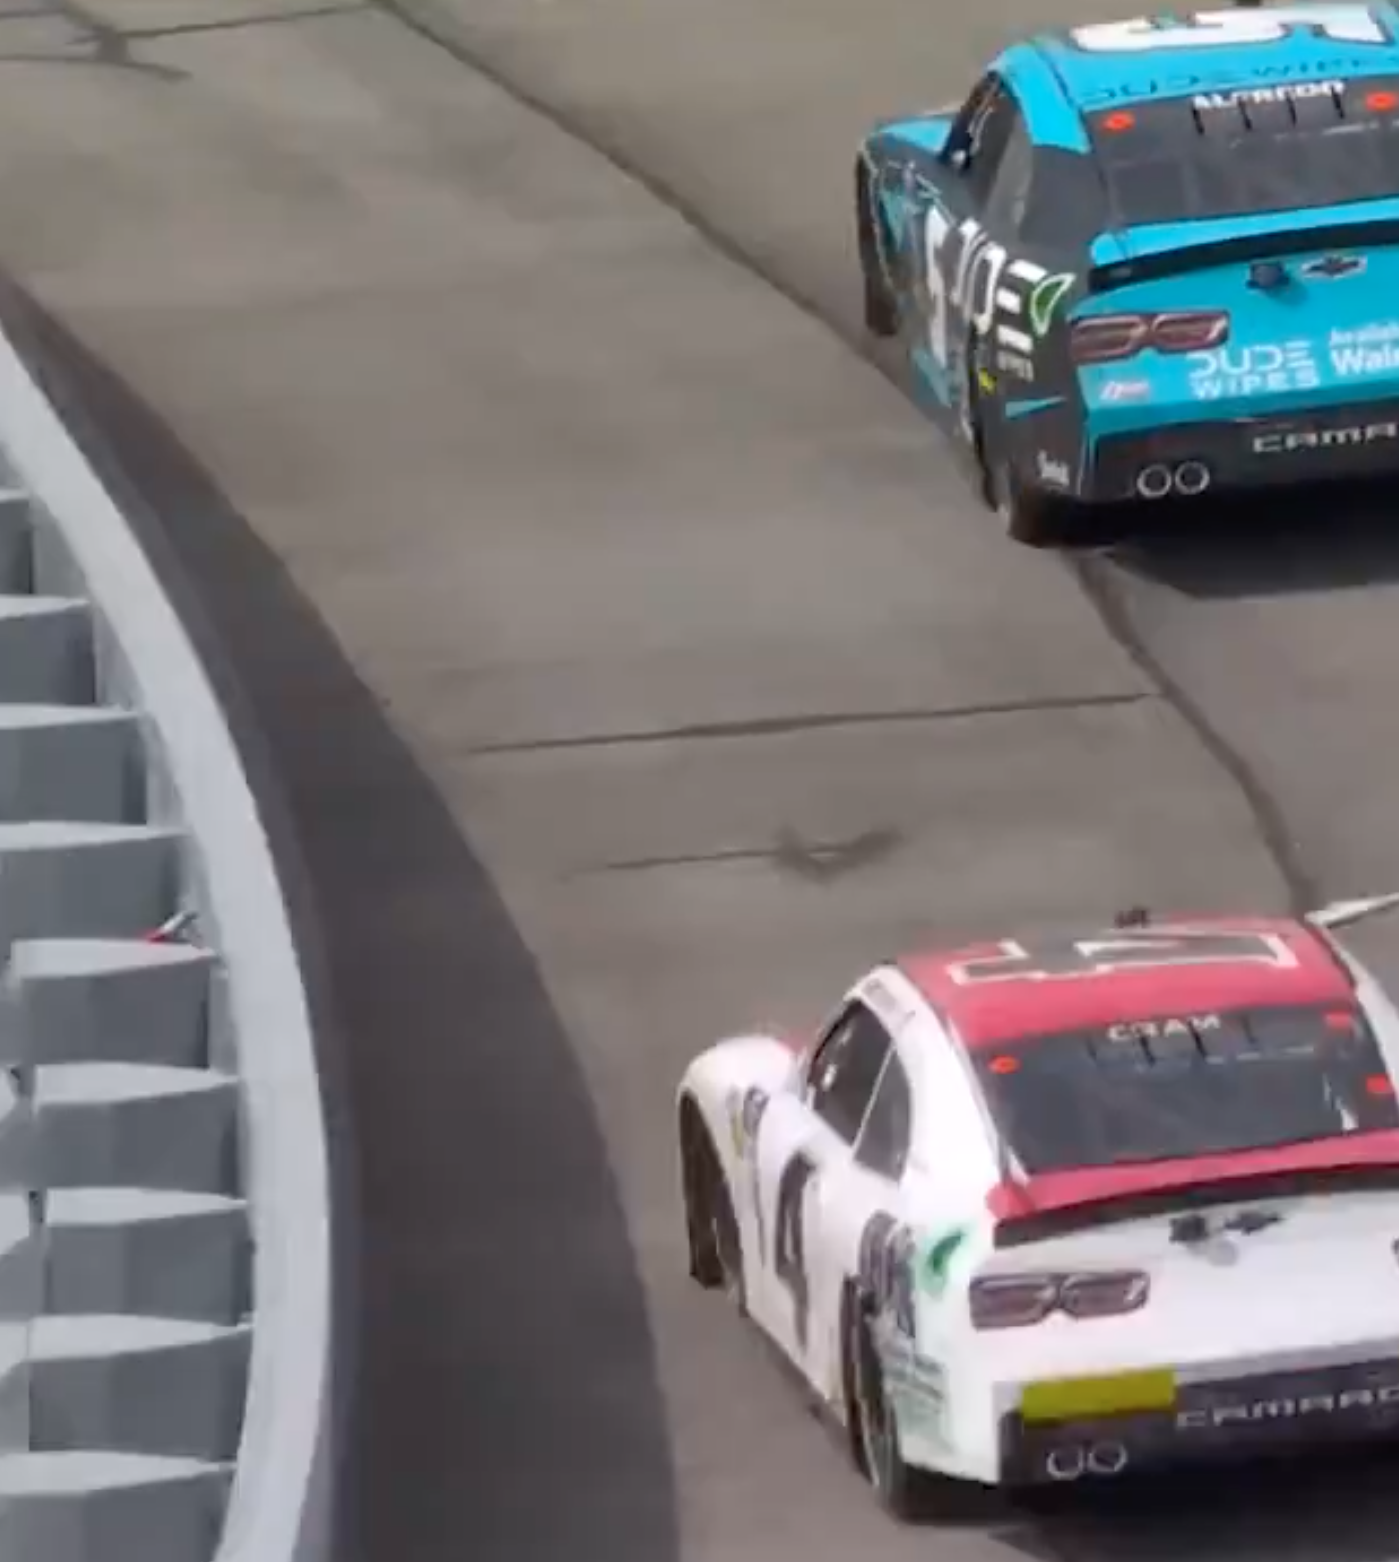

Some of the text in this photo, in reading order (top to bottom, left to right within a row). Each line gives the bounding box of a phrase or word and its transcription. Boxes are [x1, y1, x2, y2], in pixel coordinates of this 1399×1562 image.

[1186, 340, 1315, 379] DUDE
[1189, 365, 1322, 400] WIPES
[1106, 1013, 1220, 1042] CRAM
[774, 1151, 818, 1358] 4
